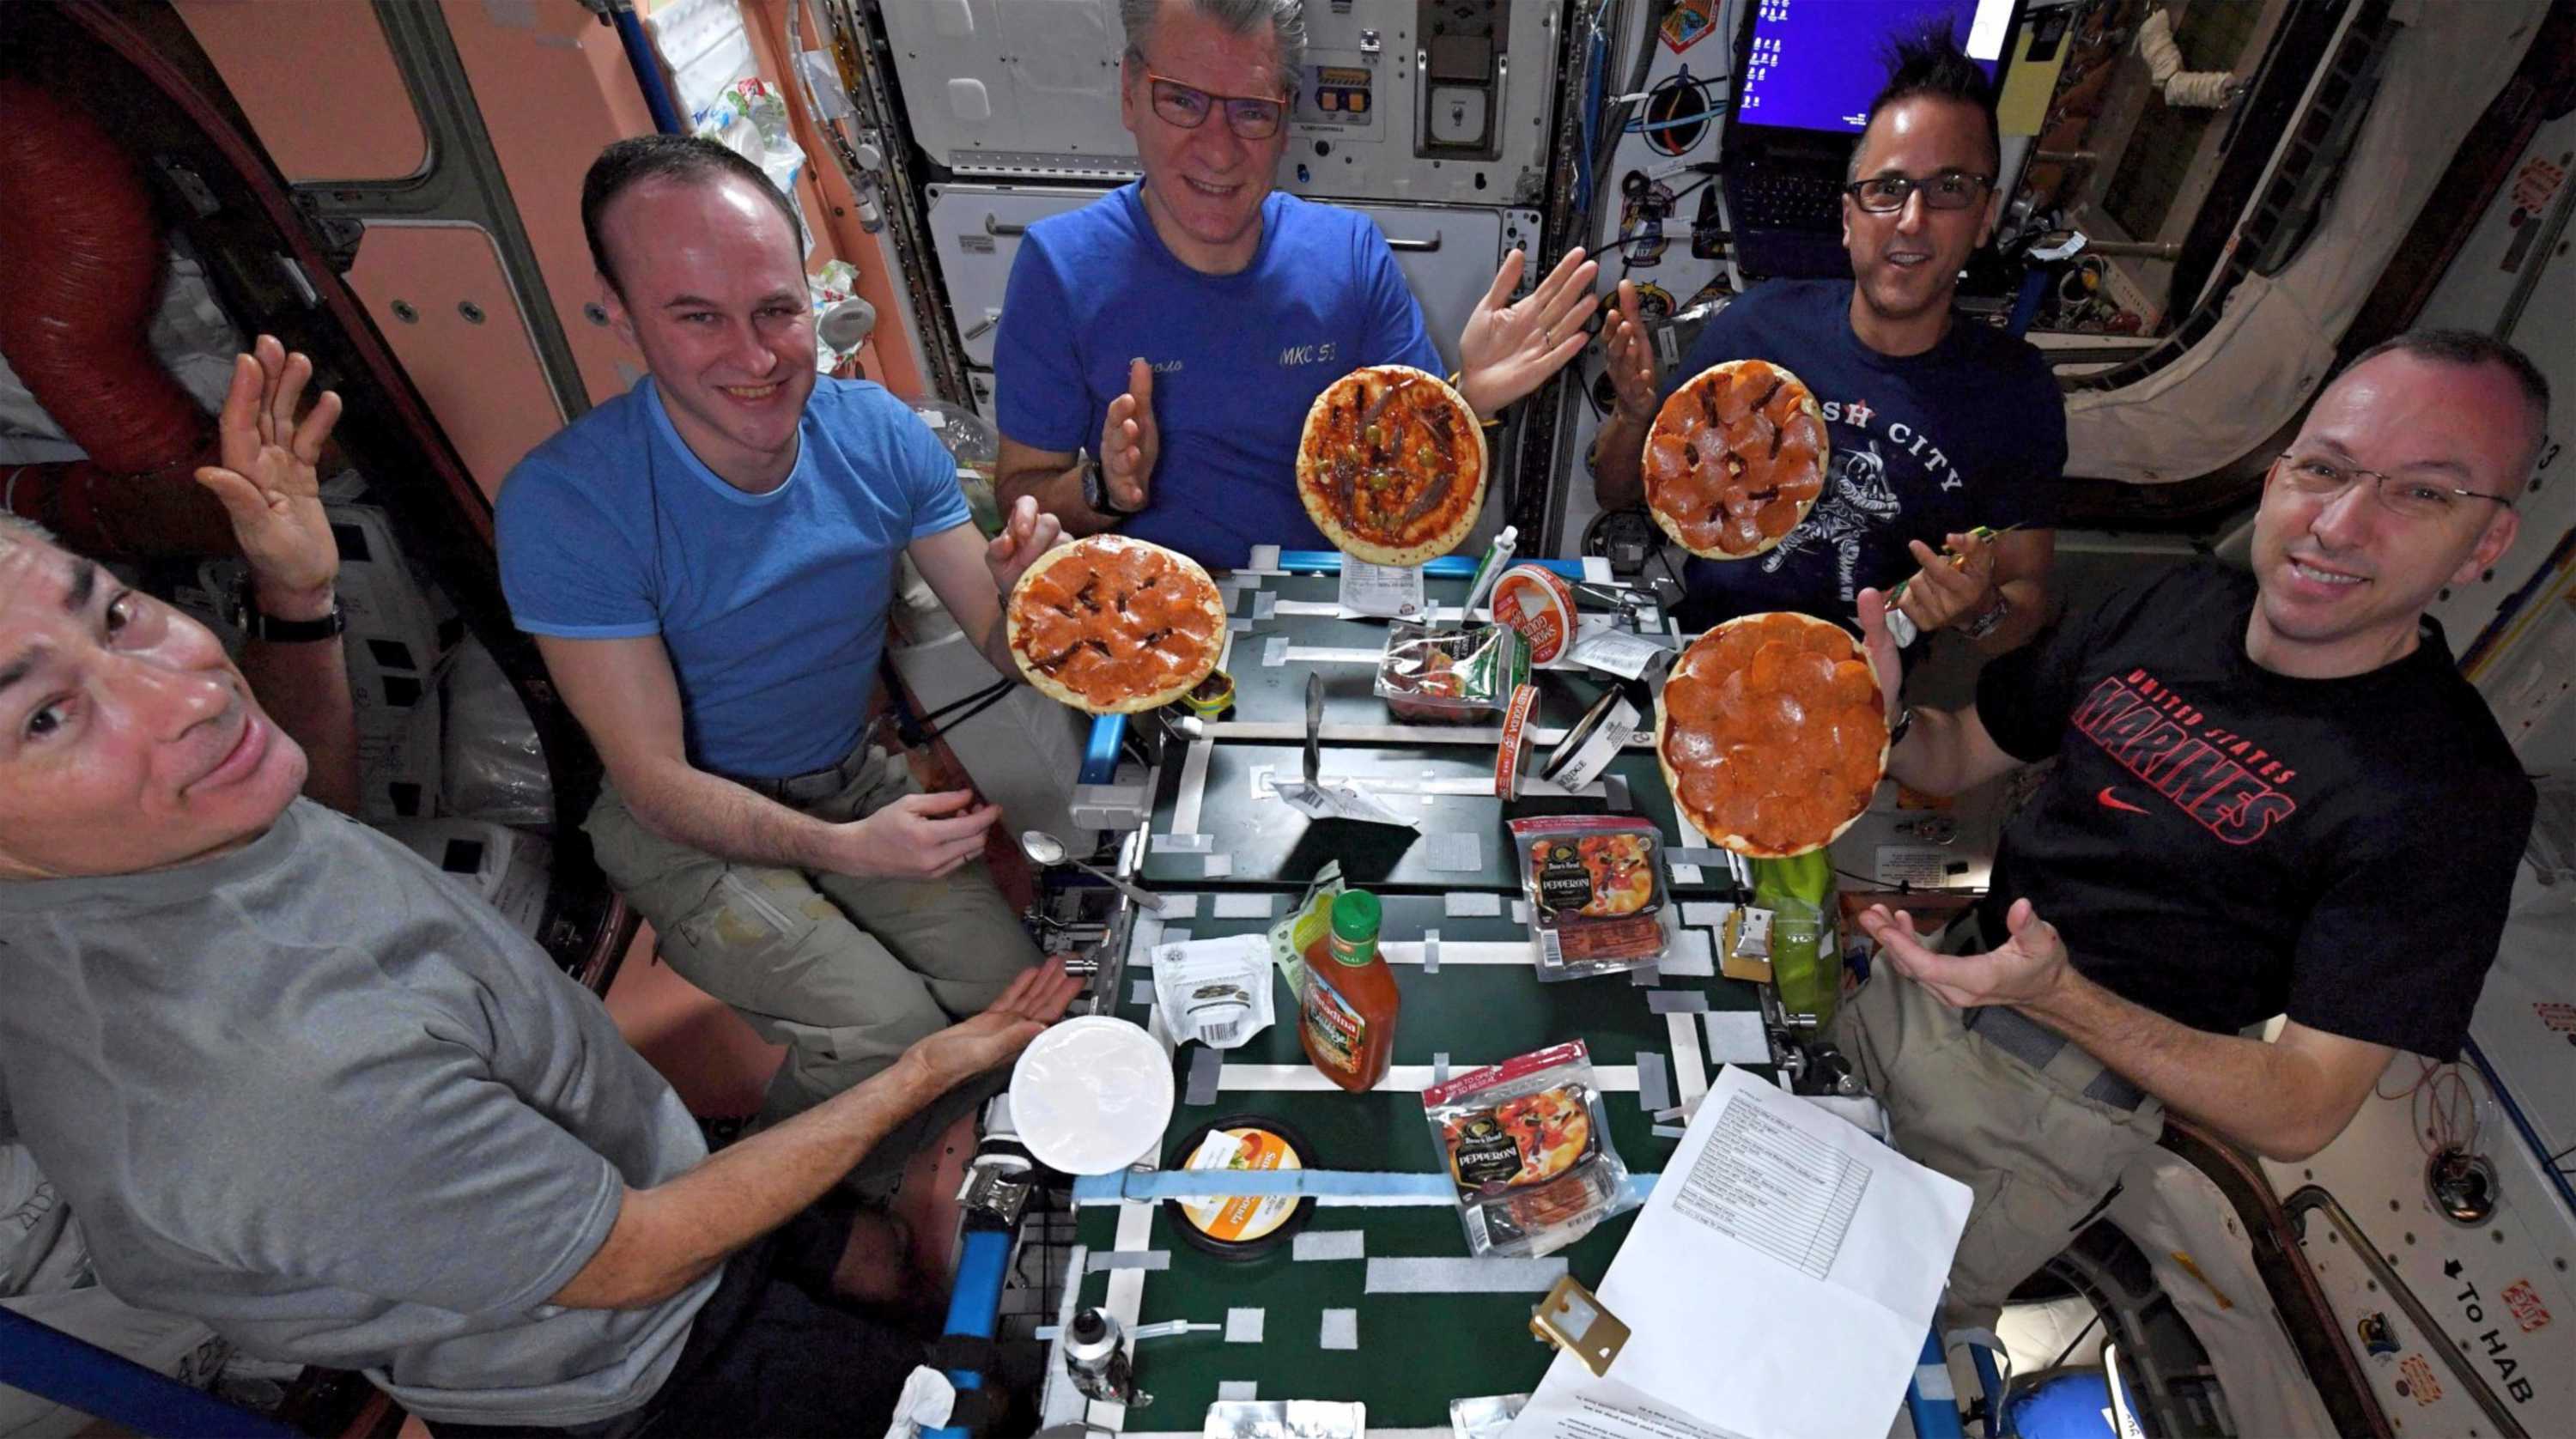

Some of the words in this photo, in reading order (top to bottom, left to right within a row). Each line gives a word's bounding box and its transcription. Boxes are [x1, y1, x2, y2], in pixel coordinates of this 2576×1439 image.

[1888, 422, 1963, 492] CITY
[1523, 615, 1548, 636] GOUD
[1529, 624, 1557, 647] SMOK
[2128, 669, 2203, 726] UNITED
[2204, 729, 2296, 784] STATES
[2070, 677, 2296, 844] MARINES
[1543, 878, 1589, 890] PEPPERONI
[1459, 1146, 1518, 1167] PEPPERONI
[2511, 1289, 2539, 1324] EXIT
[2480, 1329, 2534, 1404] HAB
